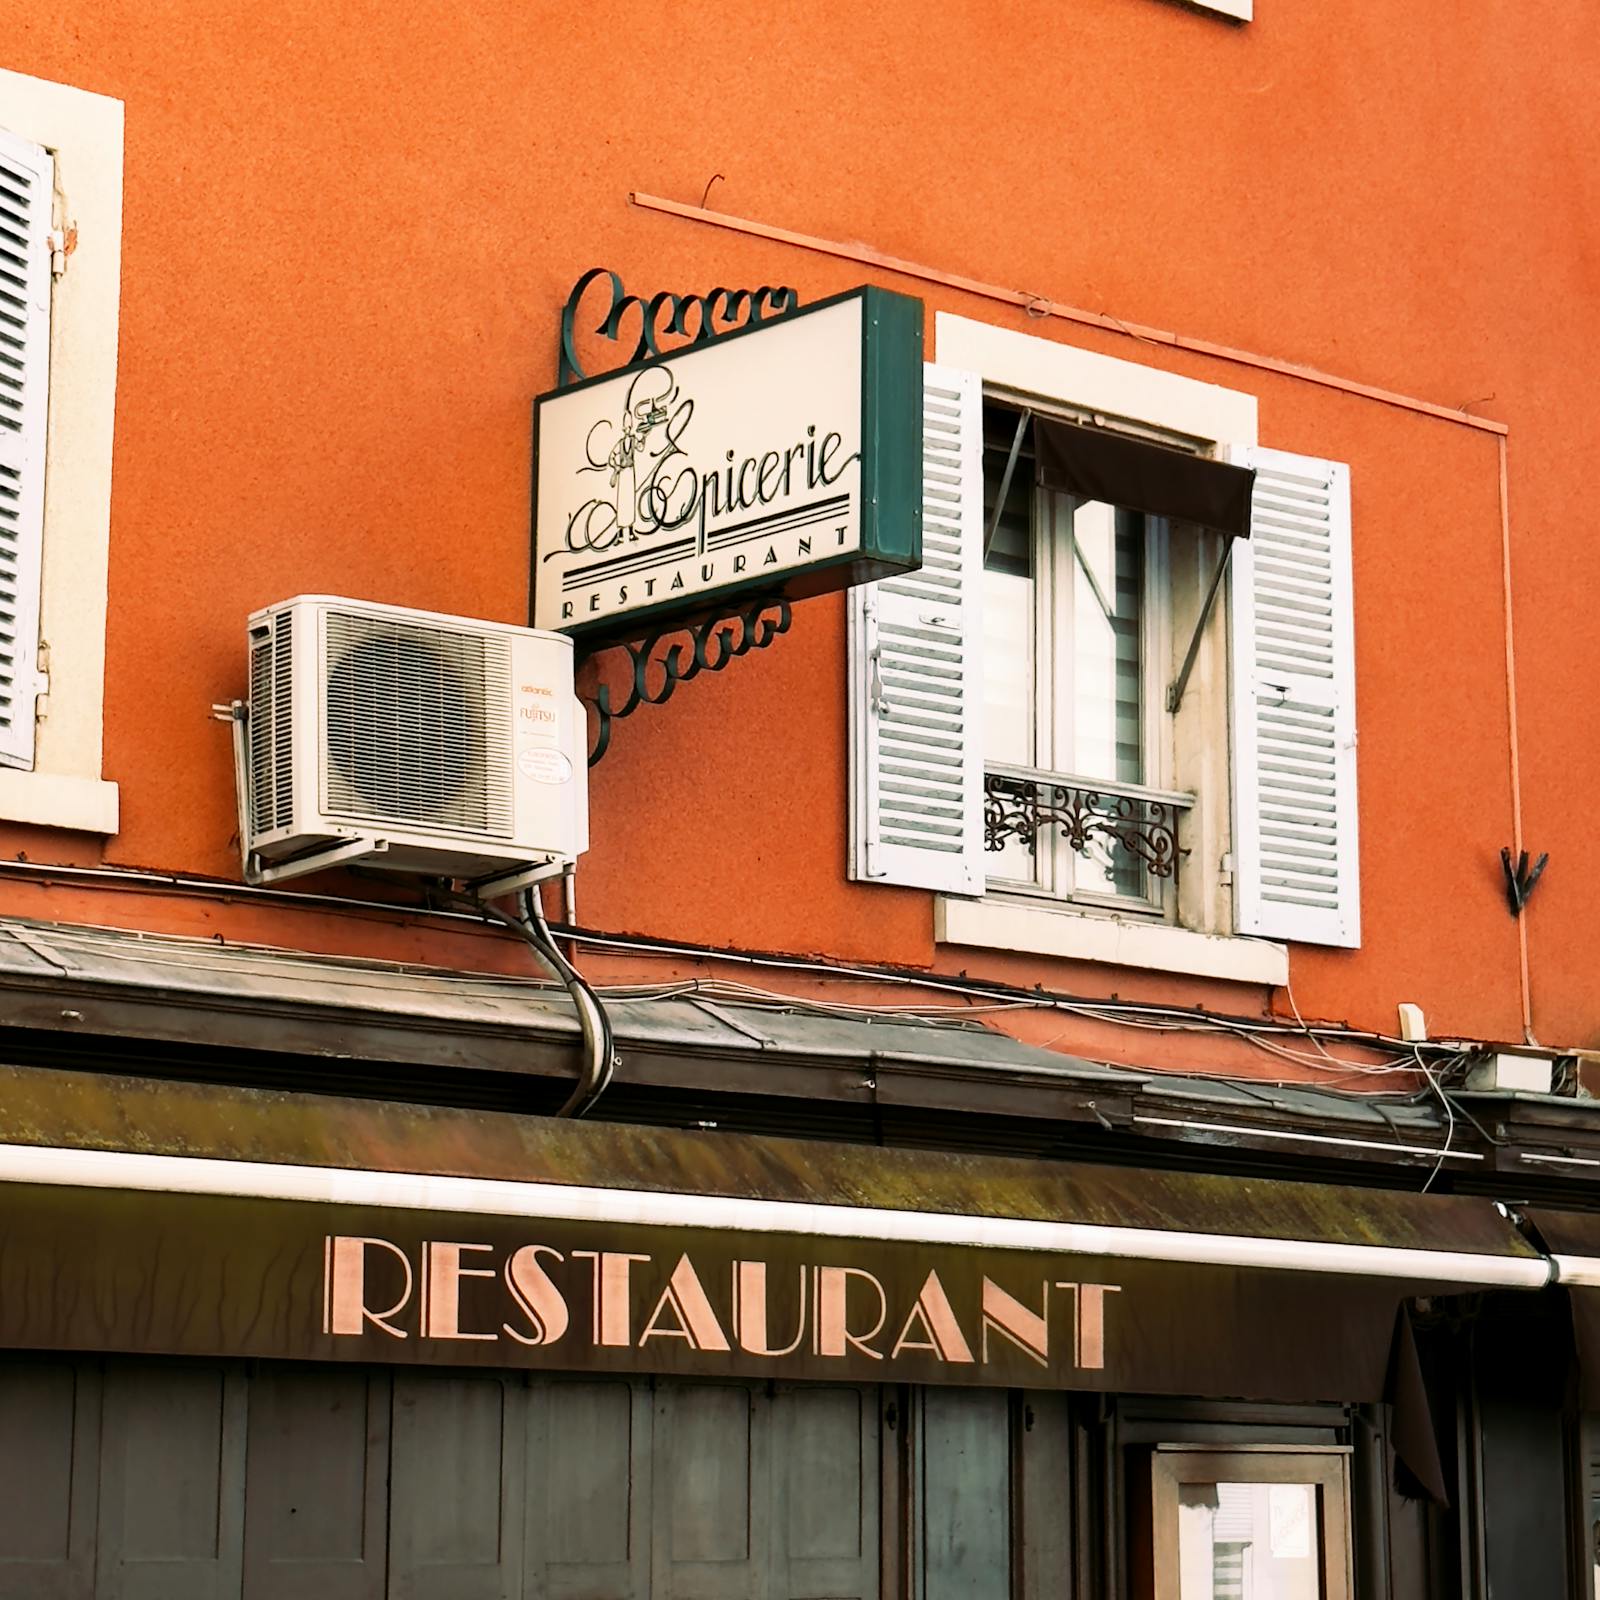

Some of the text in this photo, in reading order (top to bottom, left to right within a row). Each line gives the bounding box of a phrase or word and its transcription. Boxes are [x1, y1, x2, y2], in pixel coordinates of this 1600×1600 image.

[562, 526, 849, 618] RESTAURANT
[519, 705, 556, 723] FUJITSU
[323, 1235, 1122, 1370] RESTAURANT
